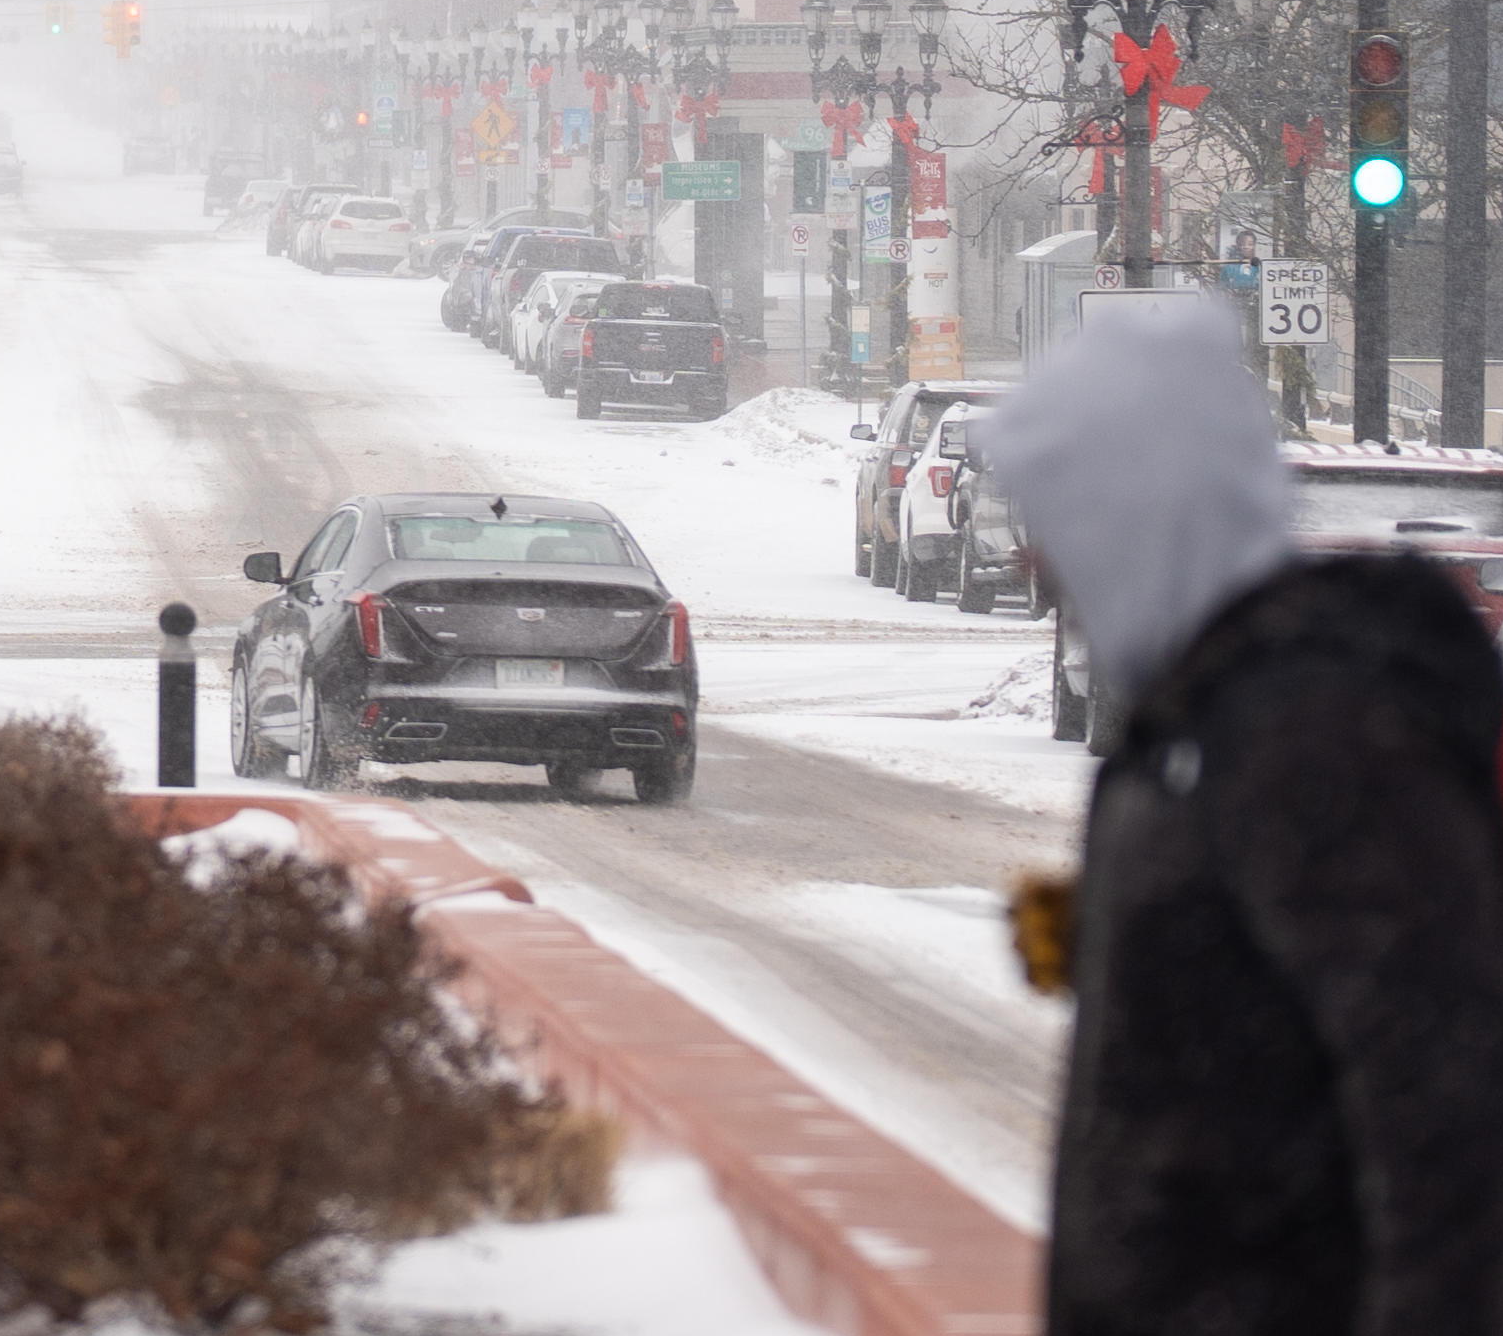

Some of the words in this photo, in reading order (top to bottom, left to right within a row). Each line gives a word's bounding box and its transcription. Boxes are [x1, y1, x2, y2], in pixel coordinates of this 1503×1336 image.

[866, 215, 889, 230] BUS
[868, 225, 890, 238] STOP
[1267, 269, 1324, 282] SPEED
[1273, 286, 1317, 299] LIMIT
[1268, 303, 1323, 335] 30
